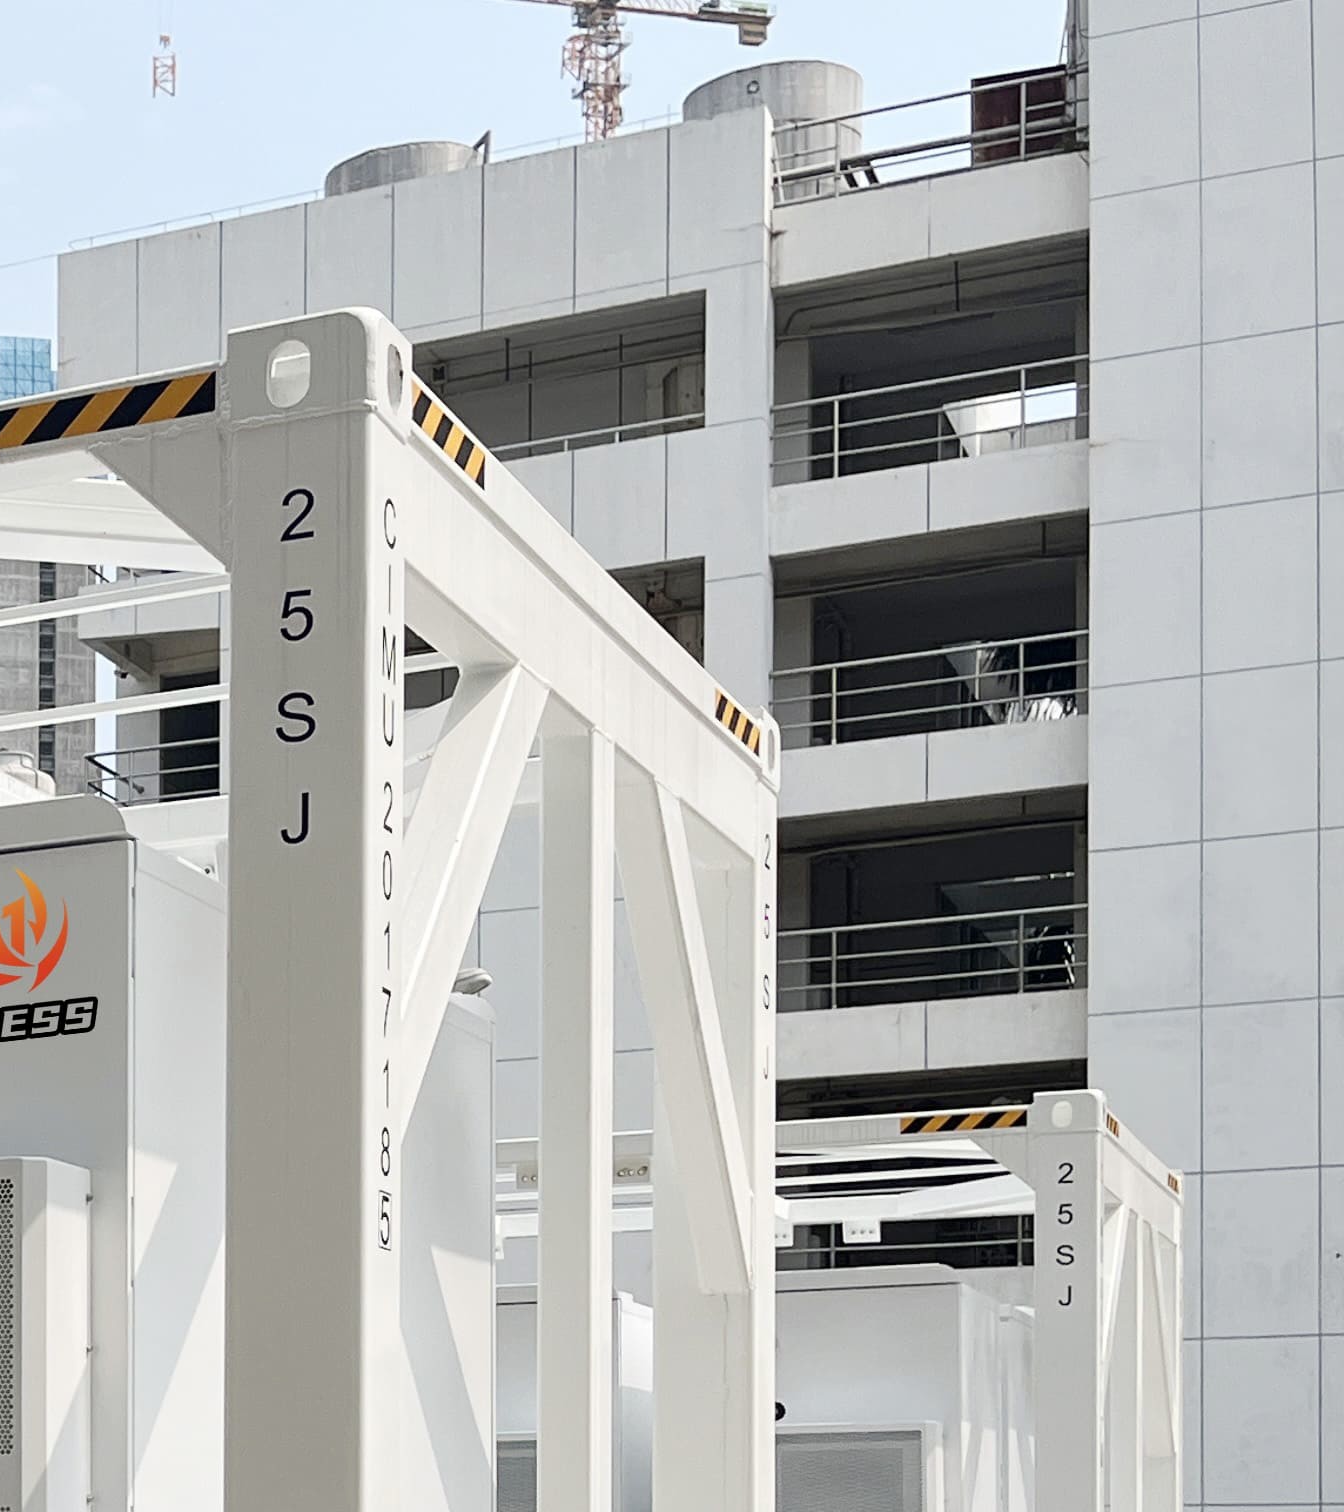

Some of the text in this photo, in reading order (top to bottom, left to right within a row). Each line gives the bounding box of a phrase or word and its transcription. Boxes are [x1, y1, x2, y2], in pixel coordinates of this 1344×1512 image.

[275, 488, 316, 845] 25SJ
[382, 498, 397, 747] CIMU
[1055, 1162, 1075, 1306] 25SJ
